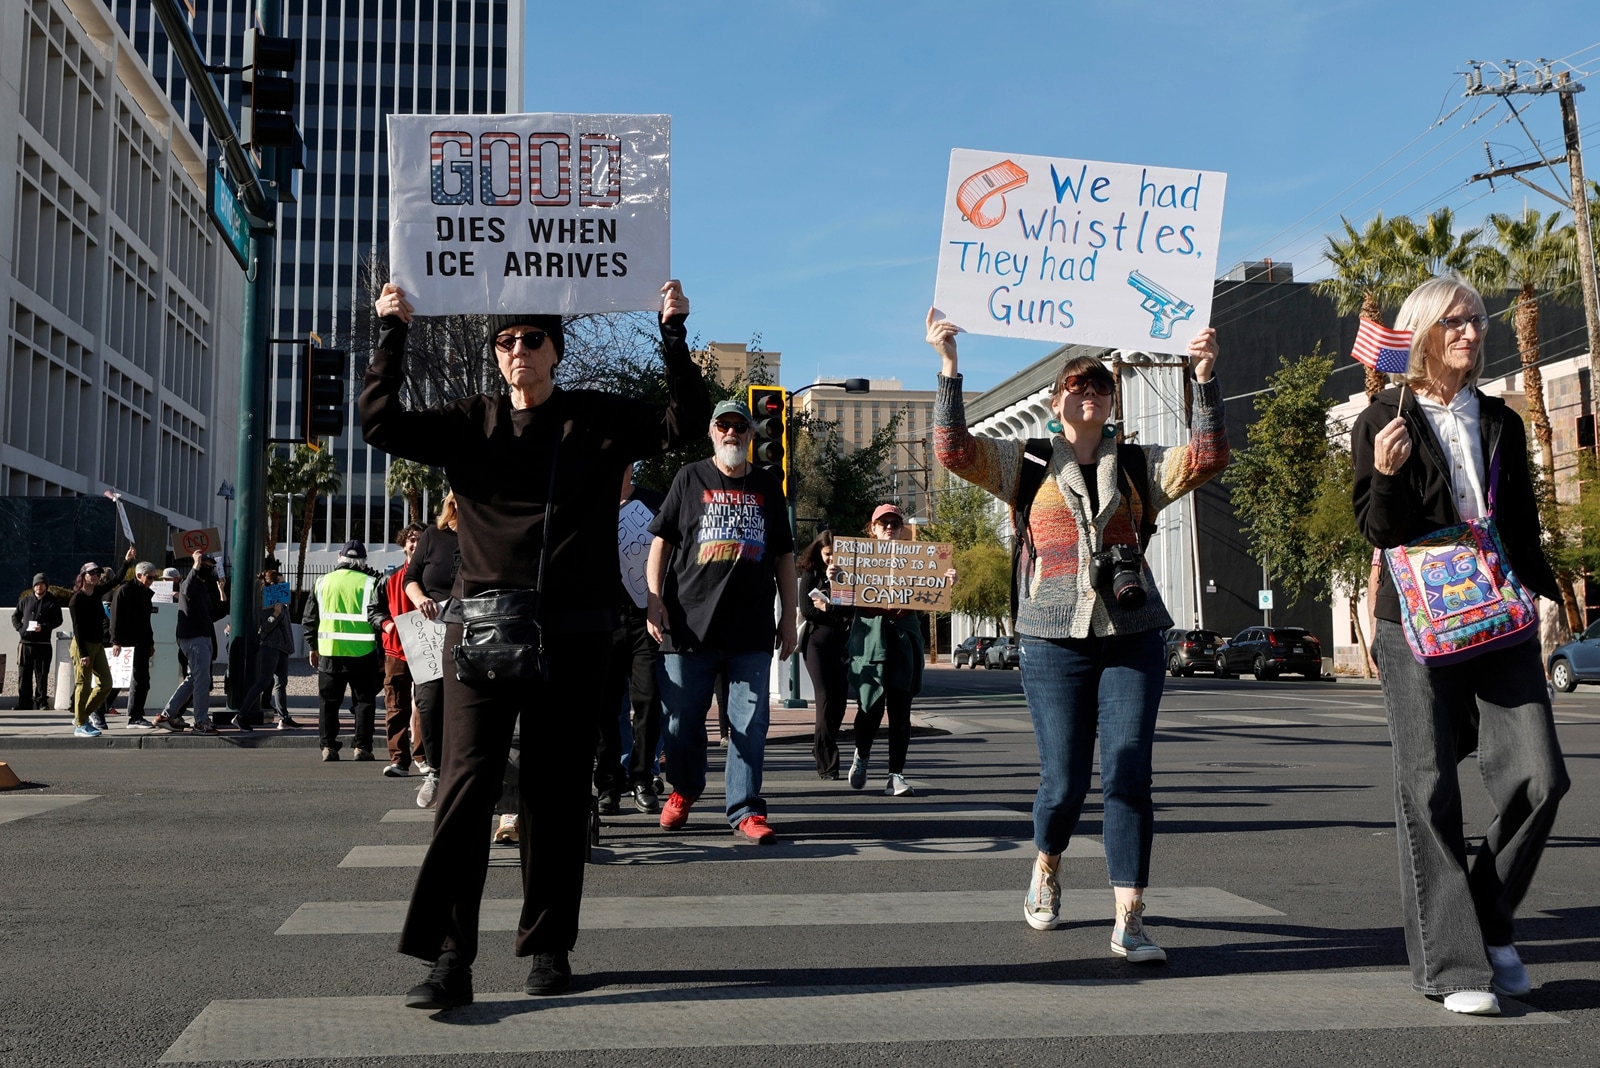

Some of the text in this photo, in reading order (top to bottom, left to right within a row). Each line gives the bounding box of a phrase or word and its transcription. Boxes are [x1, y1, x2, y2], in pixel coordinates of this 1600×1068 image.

[430, 131, 622, 207] GOOD
[1050, 163, 1202, 211] We had
[436, 216, 617, 244] DIES WHEN
[426, 251, 628, 278] ICE ARRIVES
[950, 241, 1098, 286] They had
[988, 285, 1075, 329] Guns
[618, 504, 652, 546] STICE
[622, 534, 651, 560] FOR
[834, 540, 923, 555] PRISON WITHOUT
[837, 555, 938, 570] DUE PROCESS IS A
[836, 570, 946, 588] CONCENTRATION
[861, 586, 914, 605] CAMP
[410, 614, 441, 676] CONSTITUTION
[430, 635, 439, 650] THE
